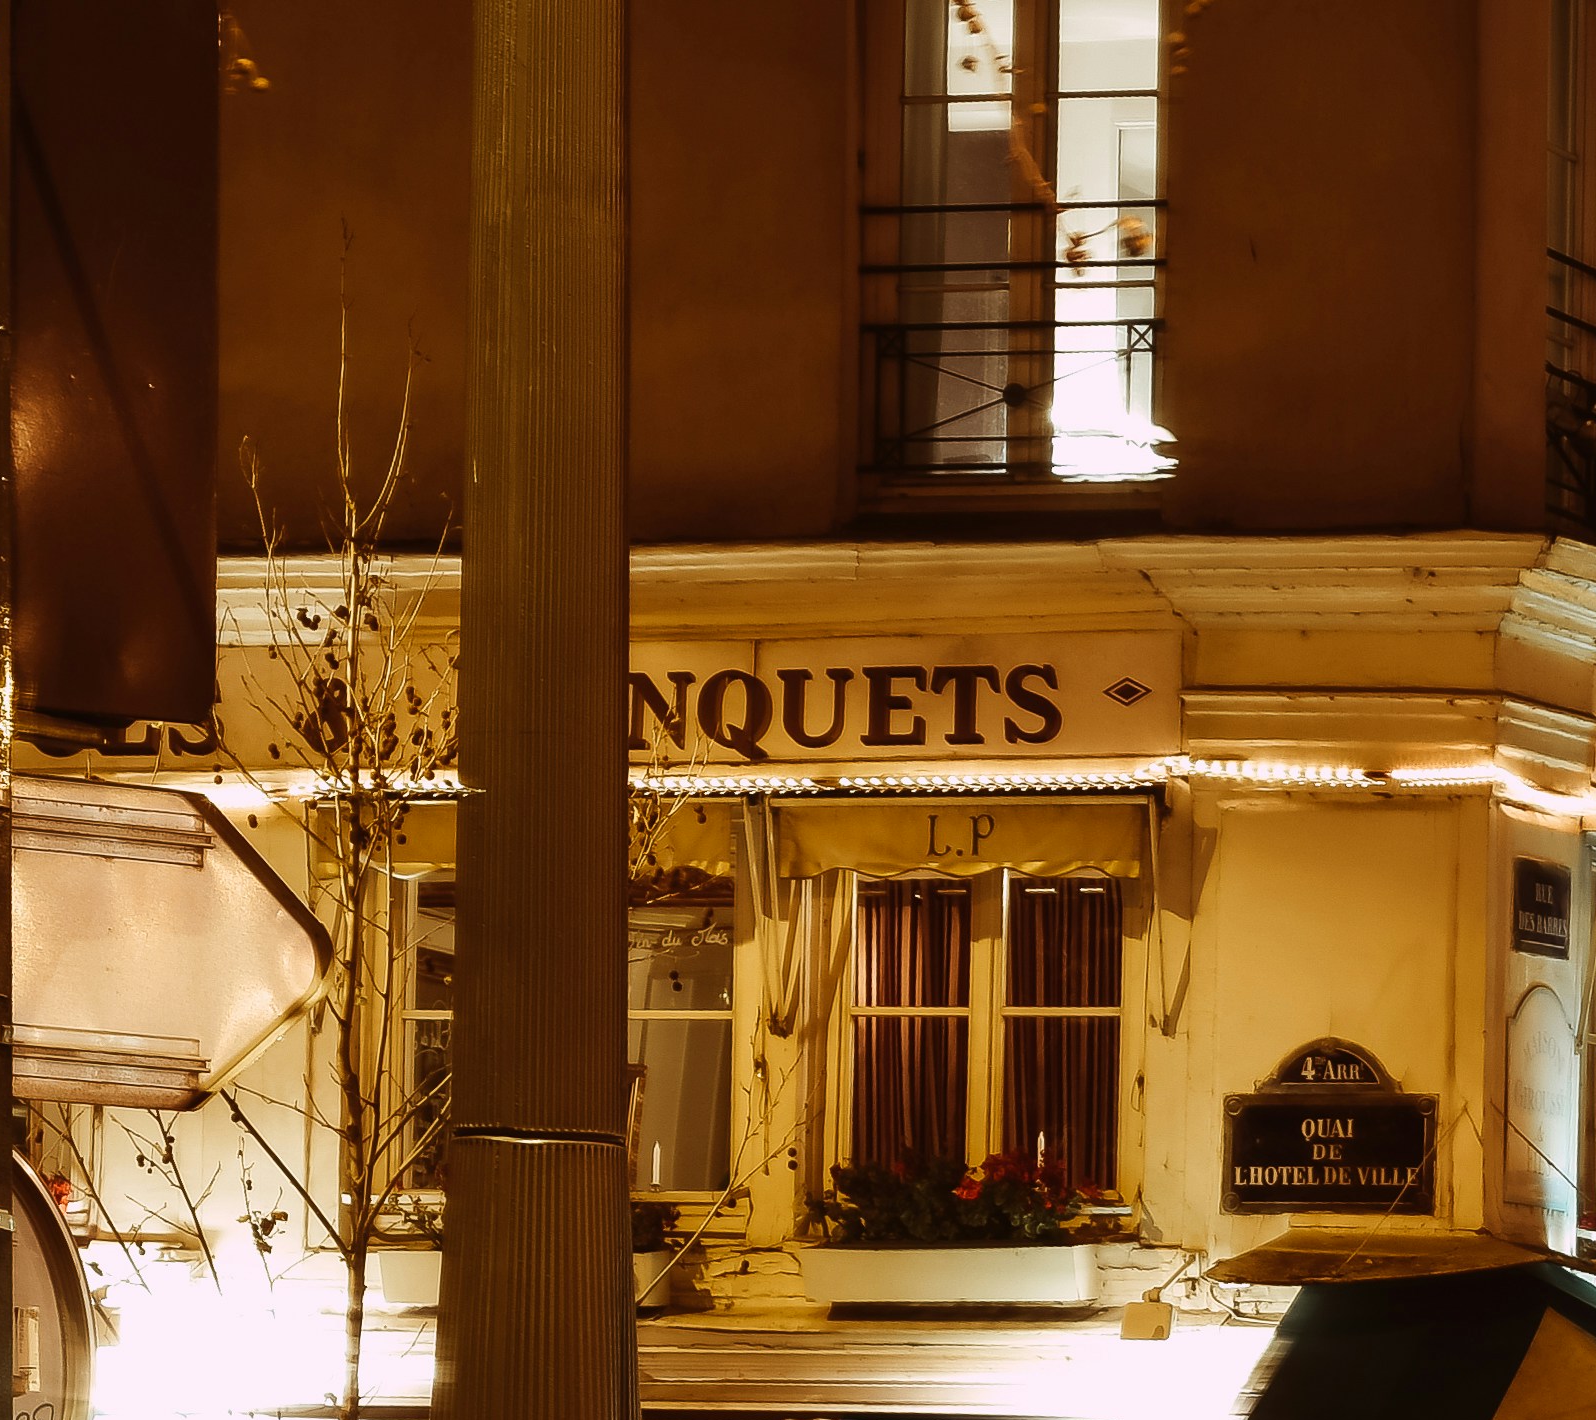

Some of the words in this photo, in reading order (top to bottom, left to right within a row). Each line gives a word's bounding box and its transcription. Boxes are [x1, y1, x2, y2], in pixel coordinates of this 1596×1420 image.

[629, 666, 1063, 760] NQUETS
[1301, 1118, 1354, 1140] QUAI
[1312, 1145, 1343, 1160] DE
[1324, 1167, 1351, 1185] DE
[1357, 1167, 1420, 1185] VILLE
